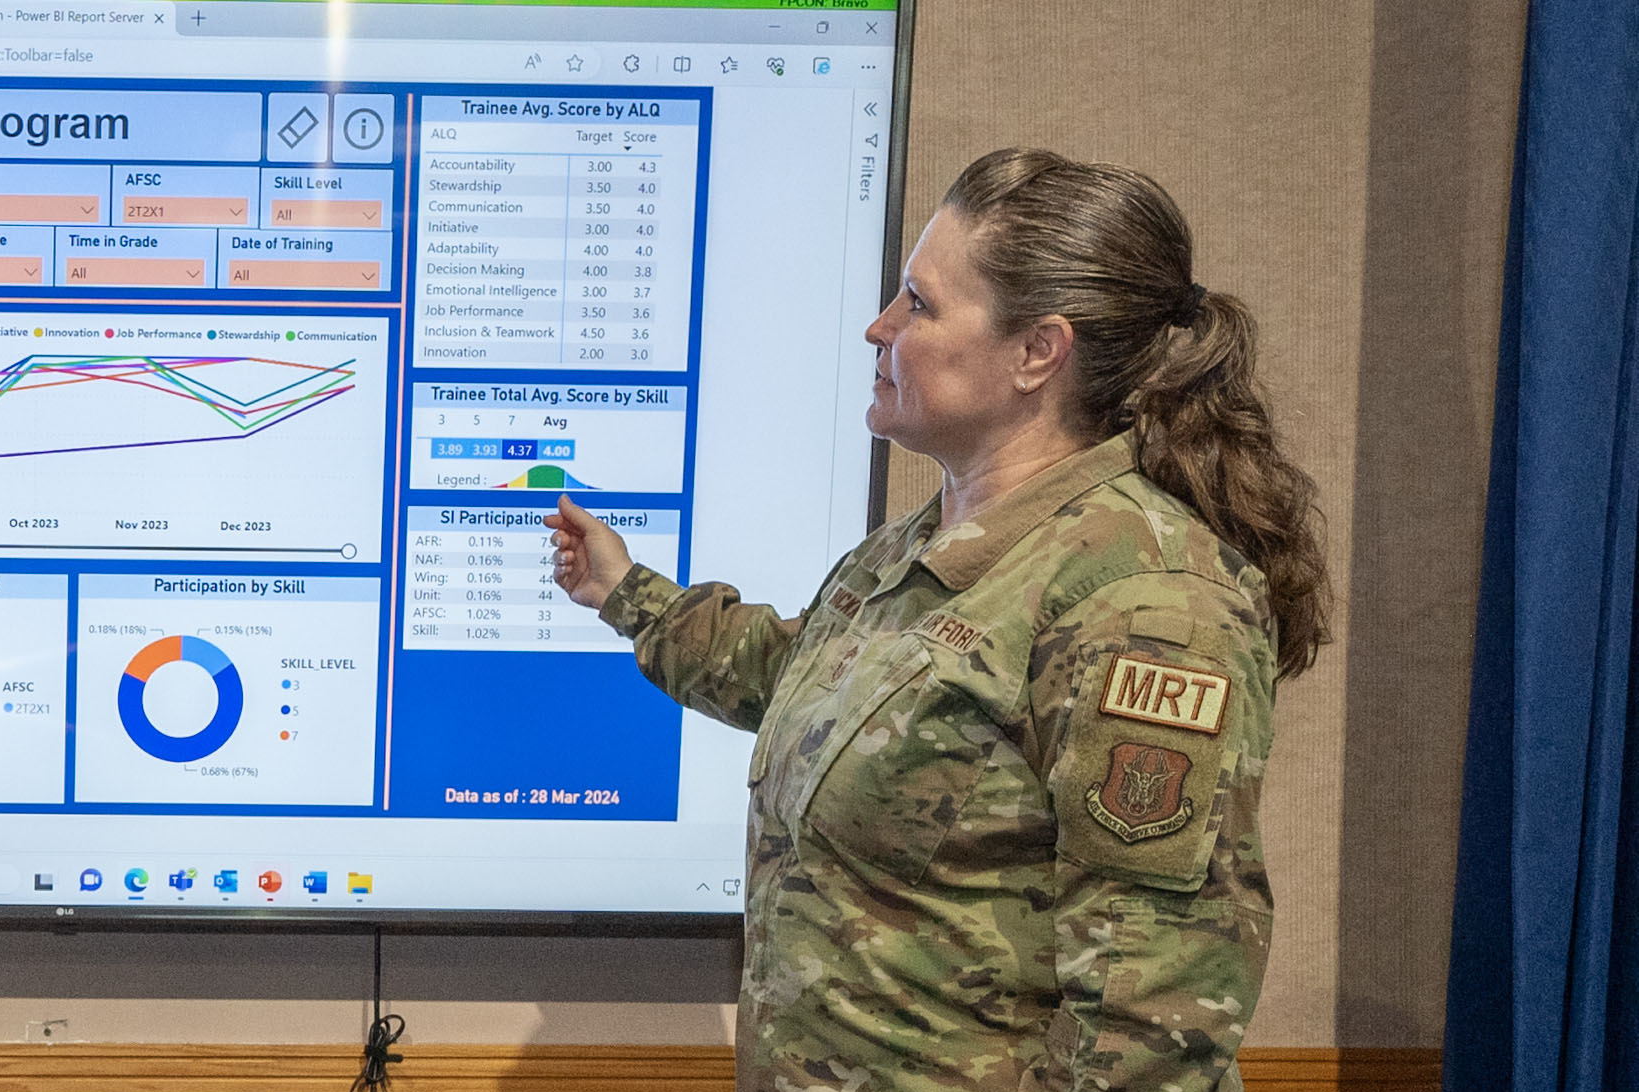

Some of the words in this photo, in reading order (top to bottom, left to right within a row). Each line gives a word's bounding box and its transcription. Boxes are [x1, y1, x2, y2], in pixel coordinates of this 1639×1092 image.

[16, 10, 50, 21] Power
[54, 11, 64, 21] BI
[68, 11, 105, 24] Report
[109, 12, 144, 23] Server
[462, 100, 517, 114] Trainee
[522, 101, 553, 118] Avg.
[558, 102, 601, 116] Score
[607, 102, 624, 119] by
[628, 103, 659, 117] ALQ
[431, 128, 456, 140] ALQ
[576, 130, 612, 145] Target
[624, 131, 656, 142] Score
[430, 159, 515, 174] Accountability
[588, 161, 612, 172] 3.00
[639, 162, 655, 173] 4.3
[126, 174, 161, 185] AFSC
[274, 176, 303, 189] Skill
[306, 177, 342, 190] Level
[860, 157, 874, 201] Filters
[430, 180, 501, 194] Stewardship
[587, 182, 611, 193] 3.50
[638, 183, 655, 193] 4.0
[128, 206, 163, 217] 2T2X1
[429, 201, 523, 212] Communication
[277, 209, 291, 220] All
[429, 221, 478, 233] Initiative
[586, 224, 609, 235] 3.00
[636, 225, 653, 236] 4.0
[69, 235, 100, 246] Time
[105, 235, 115, 247] in
[120, 235, 157, 247] Grade
[232, 237, 258, 249] Date
[264, 238, 277, 249] of
[281, 237, 333, 253] Training
[427, 242, 499, 257] Adaptability
[427, 263, 476, 274] Decision
[481, 264, 524, 279] Making
[583, 266, 607, 276] 4.00
[635, 266, 651, 277] 3.8
[426, 284, 485, 295] Emotional
[490, 285, 557, 299] Intelligence
[426, 305, 445, 315] Job
[450, 305, 523, 317] Performance
[46, 328, 99, 337] Innovation
[219, 330, 280, 342] Stewardship
[297, 331, 377, 341] Communication
[425, 325, 476, 337] Inclusion
[496, 326, 554, 338] Teamwork
[424, 347, 486, 357] Innovation
[431, 387, 486, 400] Trainee
[491, 388, 527, 401] Total
[531, 388, 561, 404] Avg.
[567, 389, 608, 402] Score
[615, 389, 631, 406] by
[636, 390, 668, 403] Skill
[544, 416, 567, 430] Avg
[508, 445, 532, 456] 4.37
[543, 446, 570, 456] 4.00
[438, 474, 480, 488] Legend
[116, 520, 138, 529] Nov
[142, 521, 168, 529] 2023
[441, 510, 454, 523] SI
[460, 511, 542, 527] Participatio
[416, 536, 441, 546] AFR:
[469, 536, 503, 547] 0.11%
[416, 554, 442, 565] NAF:
[415, 572, 448, 586] Wing:
[467, 573, 502, 583] 0.16%
[155, 578, 246, 595] Participation
[252, 580, 268, 596] by
[273, 580, 305, 593] Skill
[414, 589, 440, 600] Unit:
[539, 591, 552, 600] 44
[413, 608, 445, 618] AFSC:
[468, 609, 501, 620] 1.02%
[538, 610, 551, 621] 33
[215, 626, 243, 634] 0.15%
[246, 626, 272, 636] (15%)
[413, 624, 438, 635] Skill:
[937, 618, 983, 651] FORC
[282, 659, 355, 669] SKILL_LEVEL
[3, 682, 34, 692] AFSC
[1115, 664, 1217, 722] MRT
[16, 704, 49, 714] 2T2X1
[446, 788, 478, 802] Data
[483, 792, 500, 803] as
[504, 789, 518, 803] of
[530, 789, 547, 803] 28
[552, 790, 580, 804] Mar
[584, 790, 619, 804] 2024
